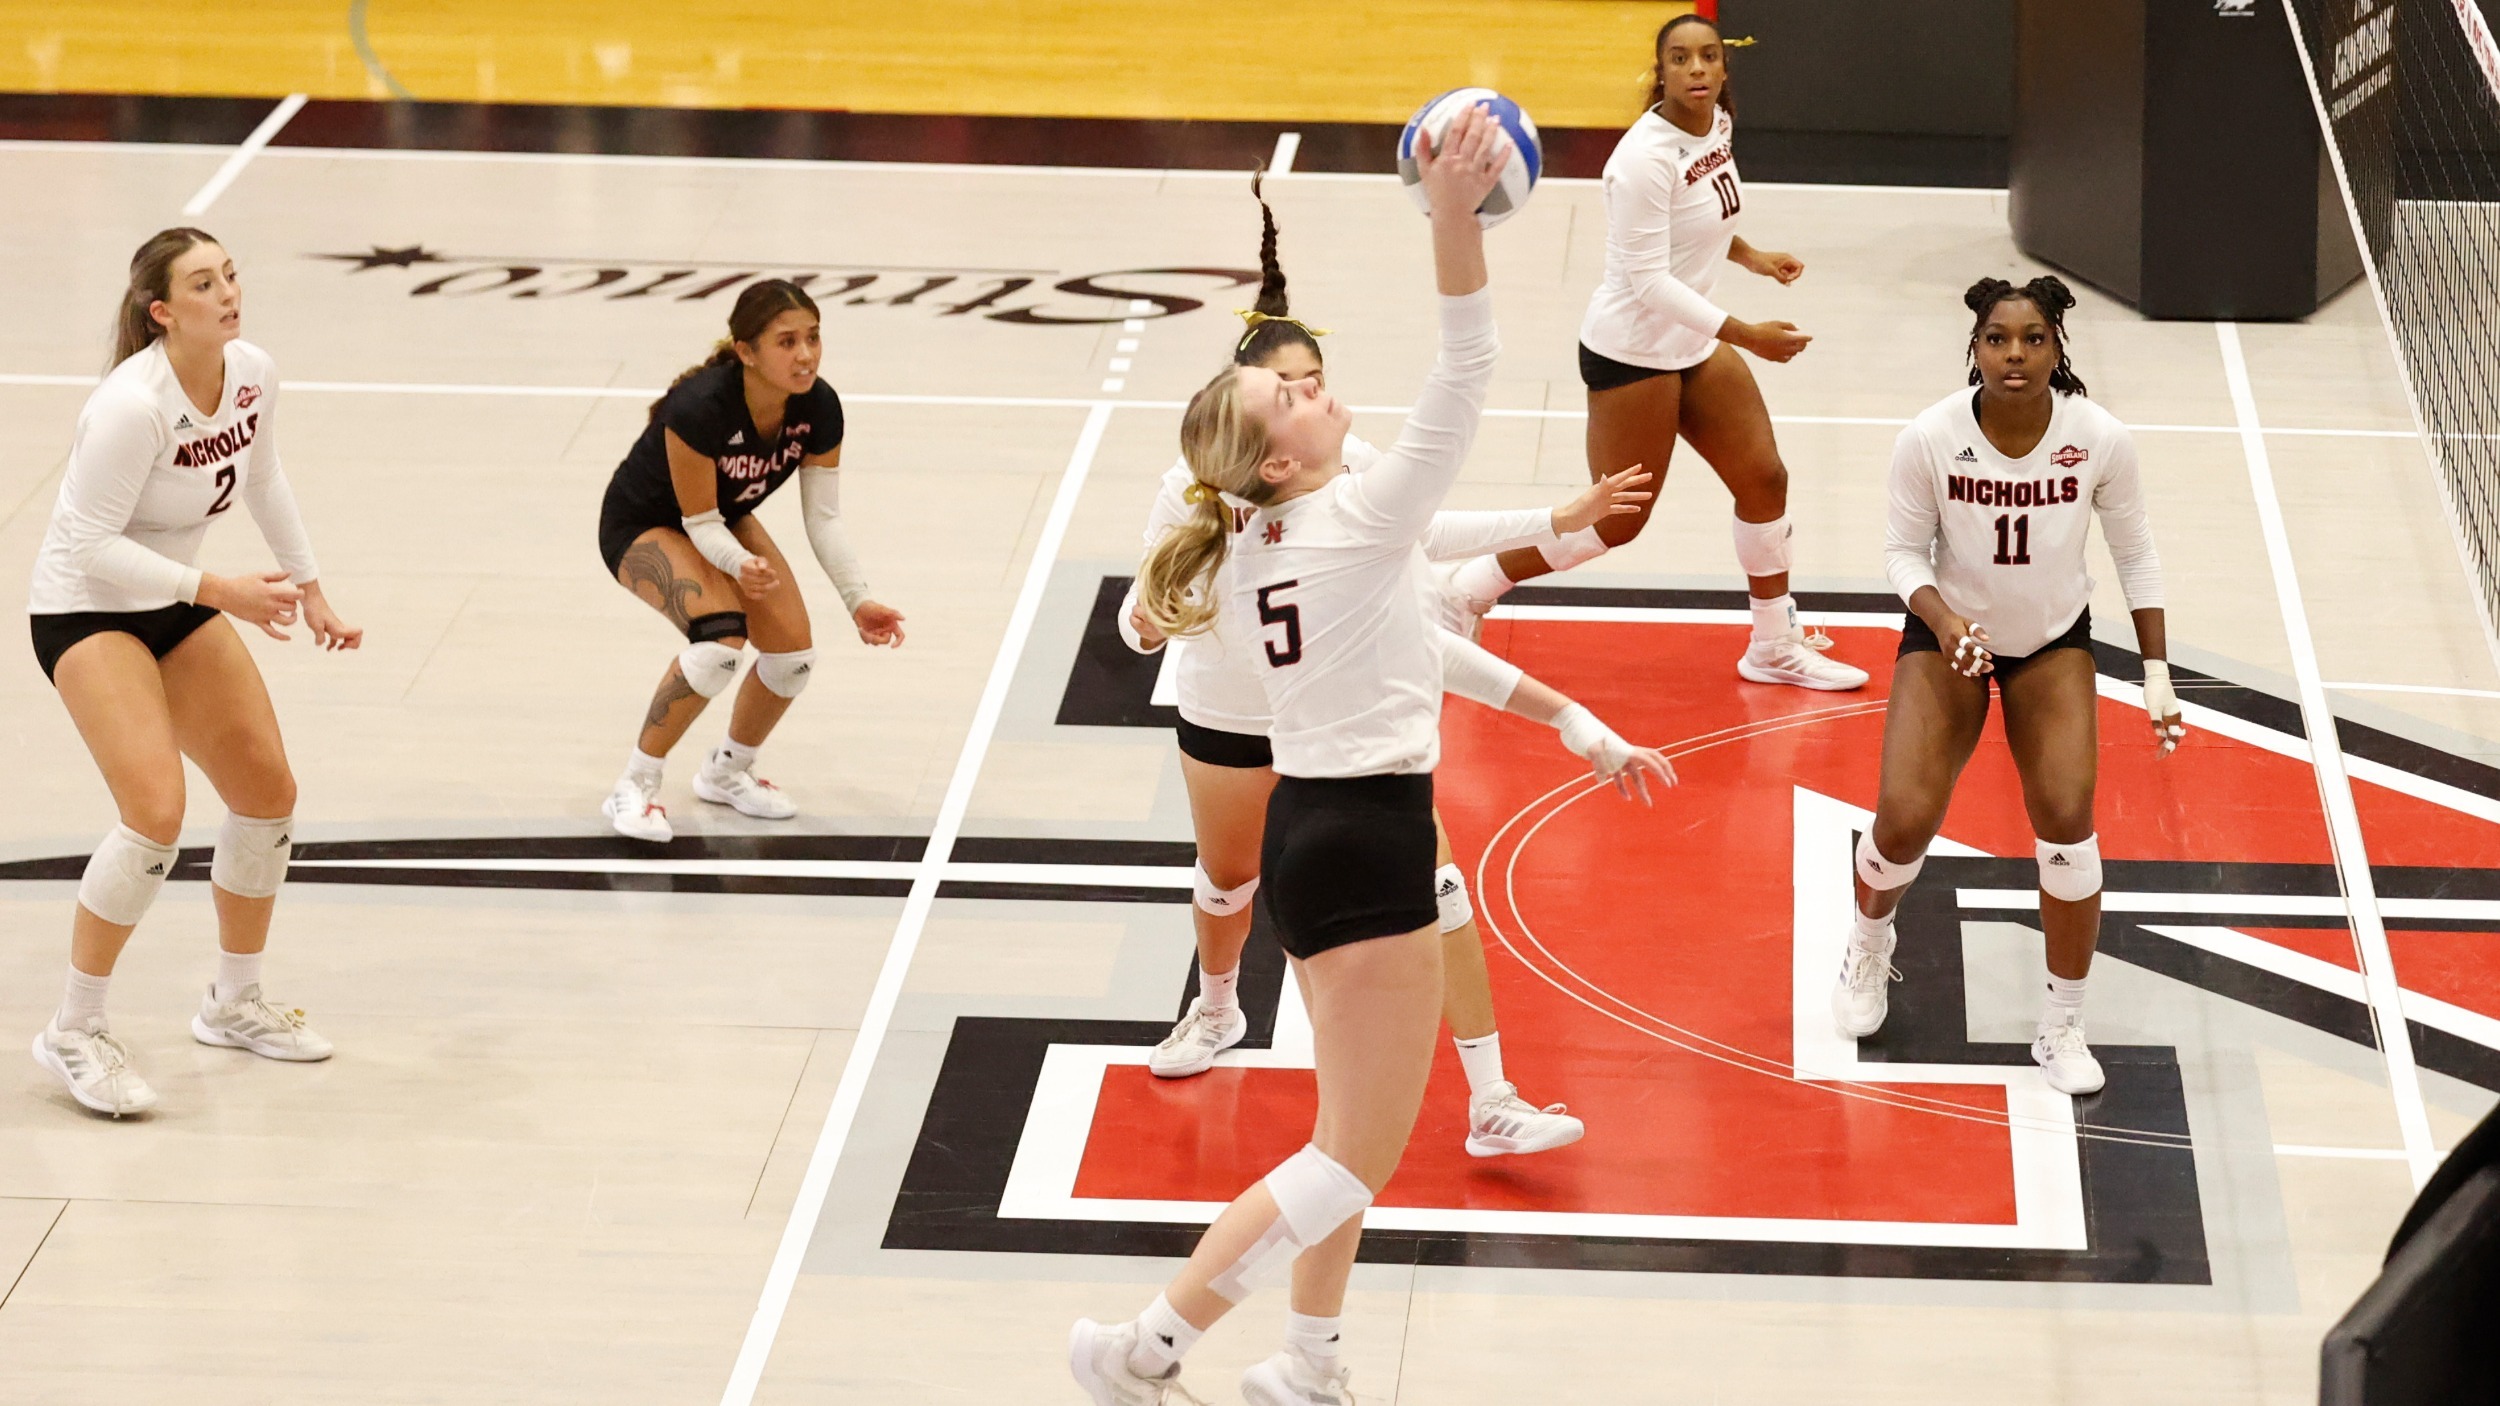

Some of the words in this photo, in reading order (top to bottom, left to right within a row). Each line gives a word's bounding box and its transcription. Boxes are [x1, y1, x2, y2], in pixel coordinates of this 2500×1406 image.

[1711, 171, 1740, 221] 10
[1954, 455, 1978, 463] adidas
[205, 463, 237, 517] 2
[1948, 474, 2079, 508] NICHOLLS
[1993, 514, 2031, 566] 11
[1257, 579, 1303, 669] 5
